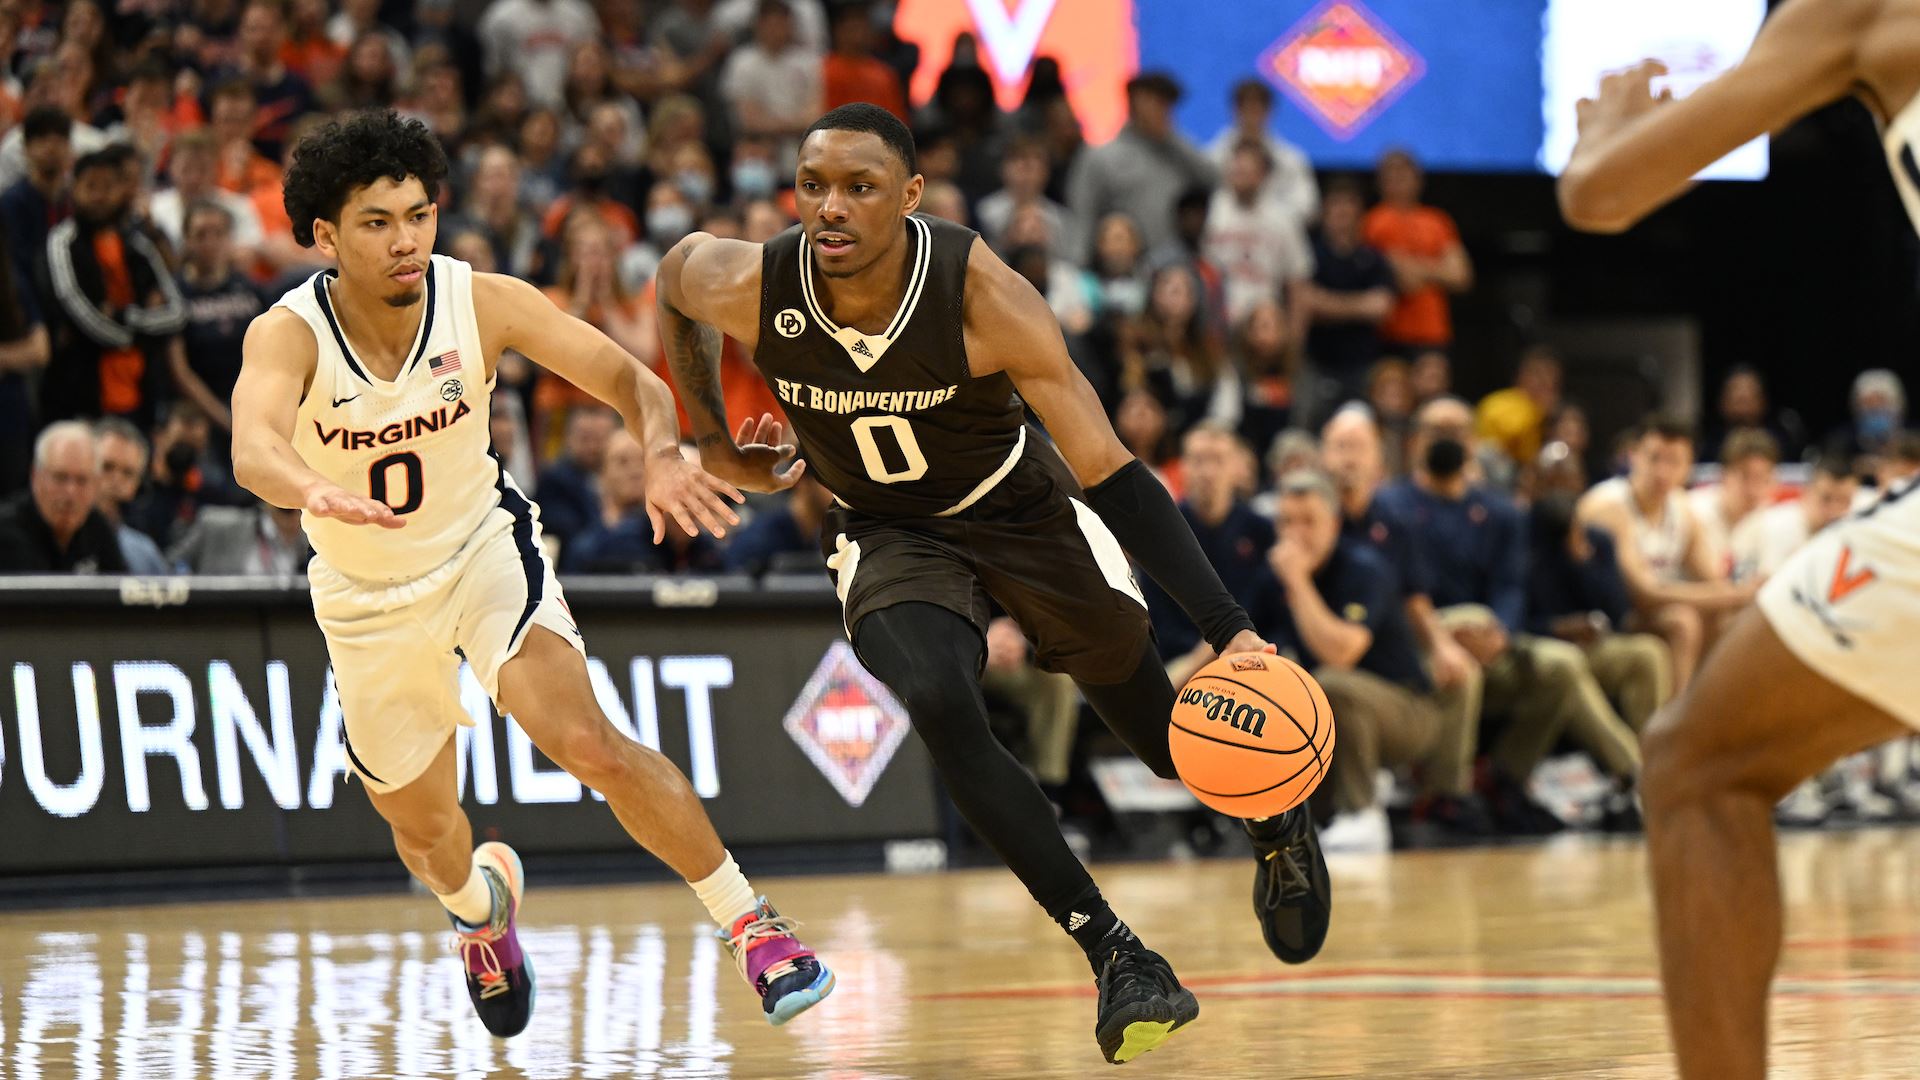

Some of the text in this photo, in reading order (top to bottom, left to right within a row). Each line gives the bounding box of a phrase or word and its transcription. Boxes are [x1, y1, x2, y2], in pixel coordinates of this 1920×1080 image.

[313, 399, 471, 450] VIRGINIA
[775, 377, 958, 415] ST. BONAVENTURE
[850, 415, 929, 485] 0
[368, 450, 424, 516] 0
[0, 655, 734, 818] URNAENT
[1179, 687, 1267, 739] Wilson
